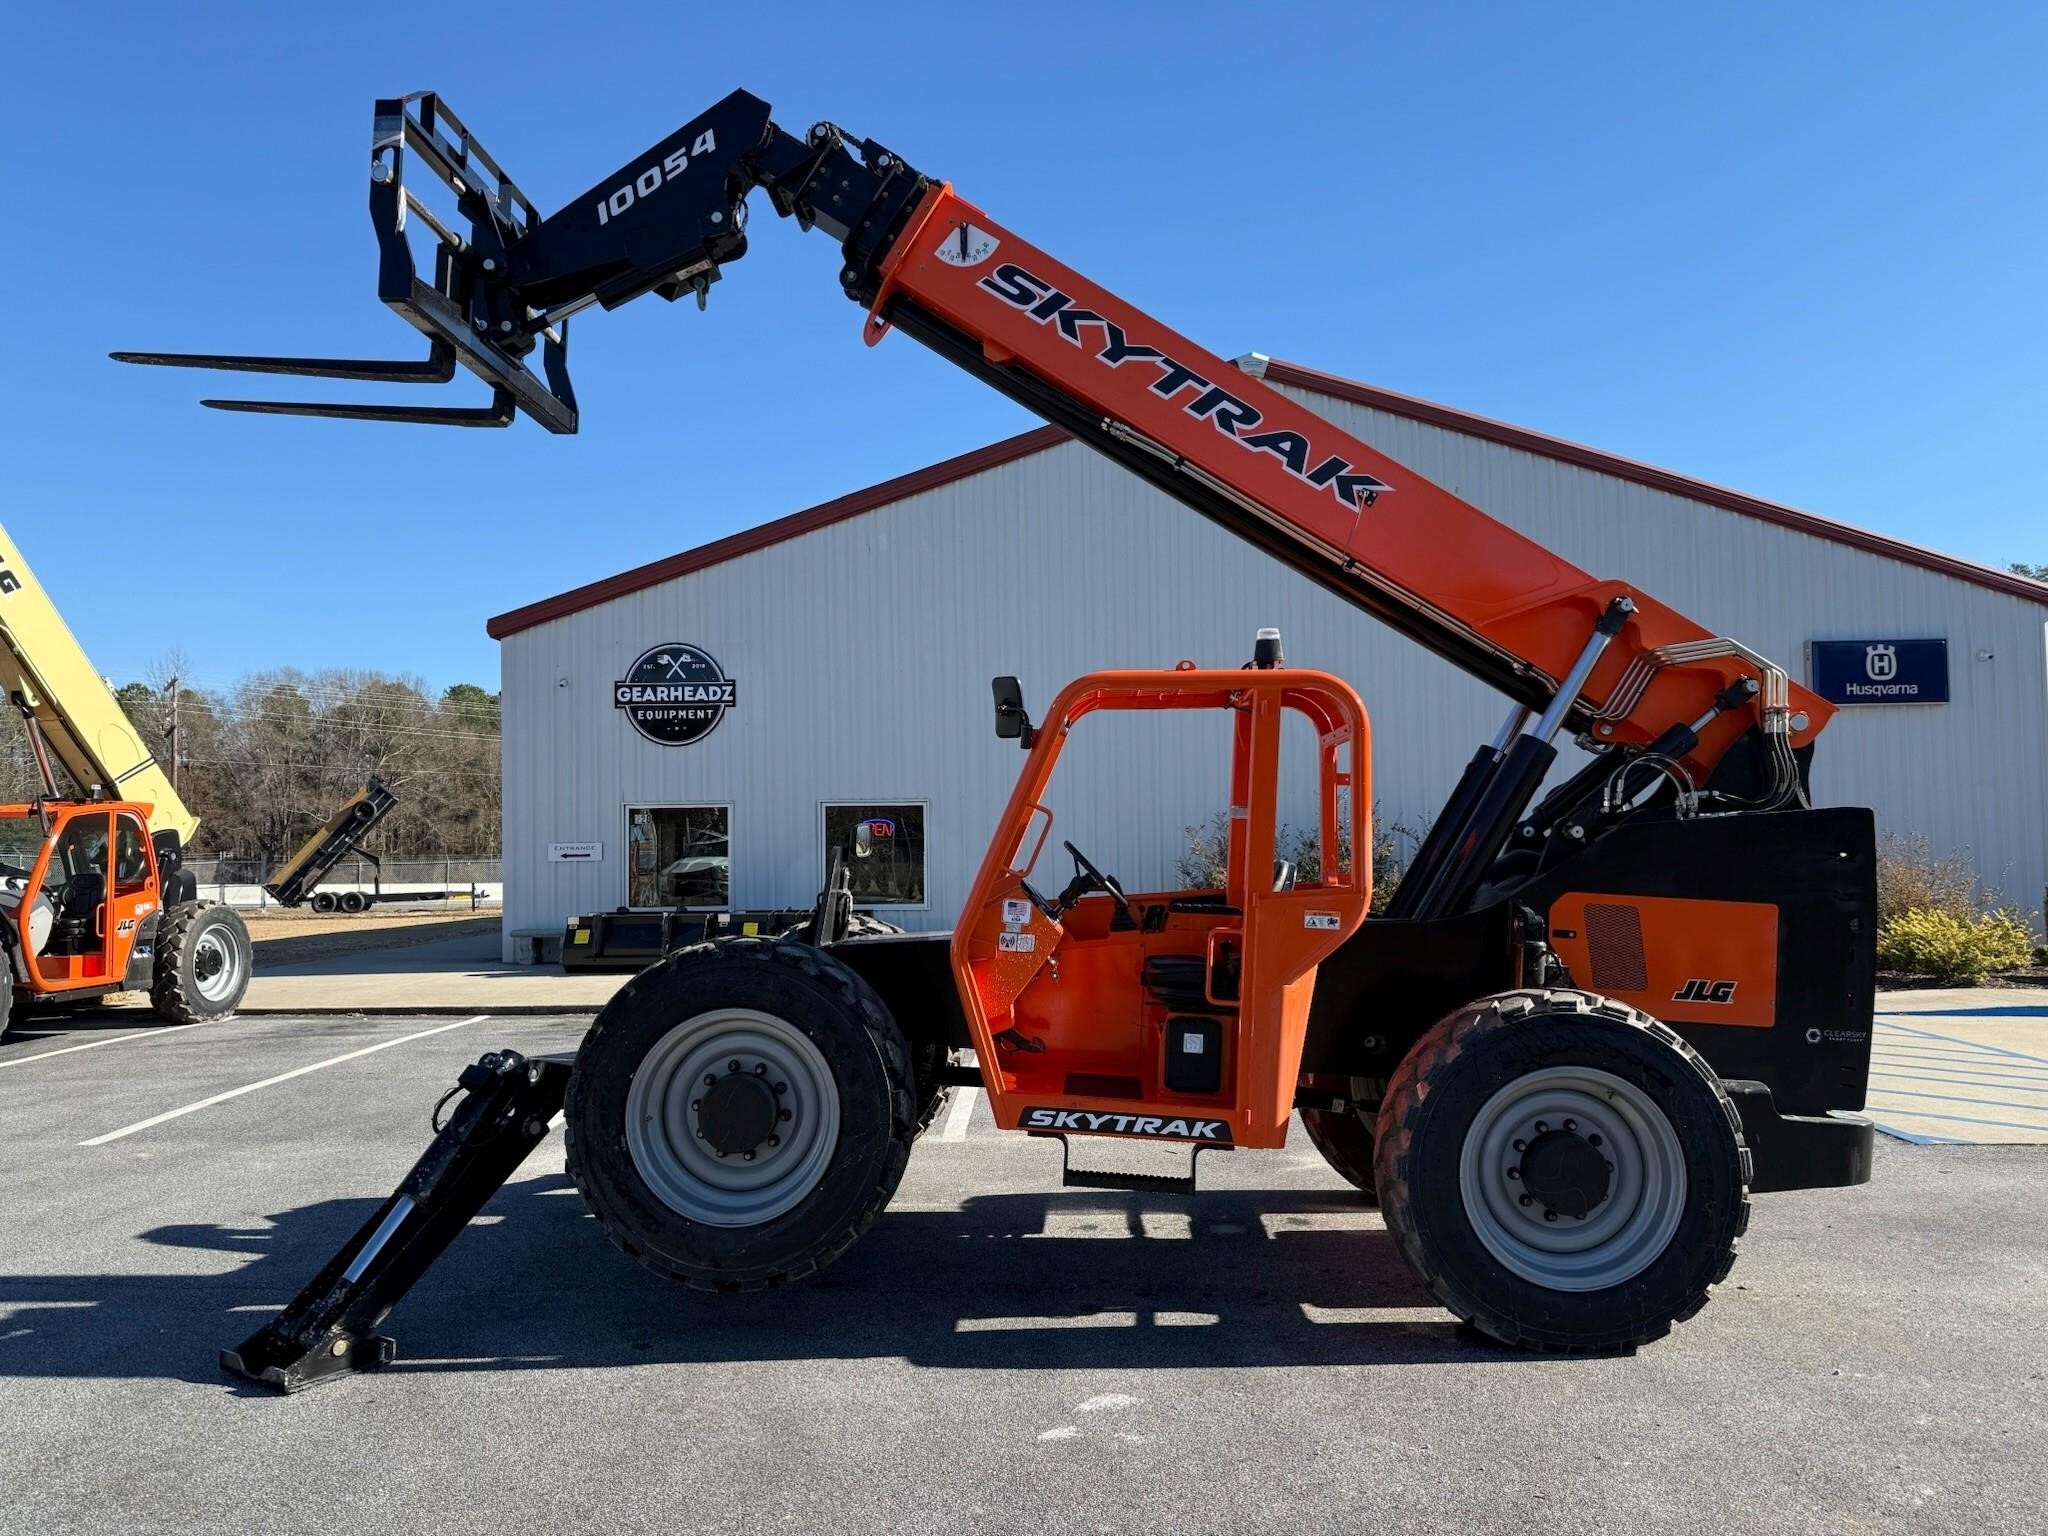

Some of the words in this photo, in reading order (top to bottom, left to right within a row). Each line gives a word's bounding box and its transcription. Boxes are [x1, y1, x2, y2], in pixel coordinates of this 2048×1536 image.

[597, 128, 717, 226] 10054
[976, 263, 1395, 513] SKYTRAK
[617, 686, 734, 702] GEARHEADZ
[1846, 683, 1918, 697] Husqvarna
[637, 709, 714, 720] EQUIPMENT
[117, 919, 135, 931] JLG
[1672, 979, 1738, 1004] JLG
[1823, 1029, 1867, 1039] CLEARSKY
[1028, 1109, 1221, 1138] SKYTRAK
